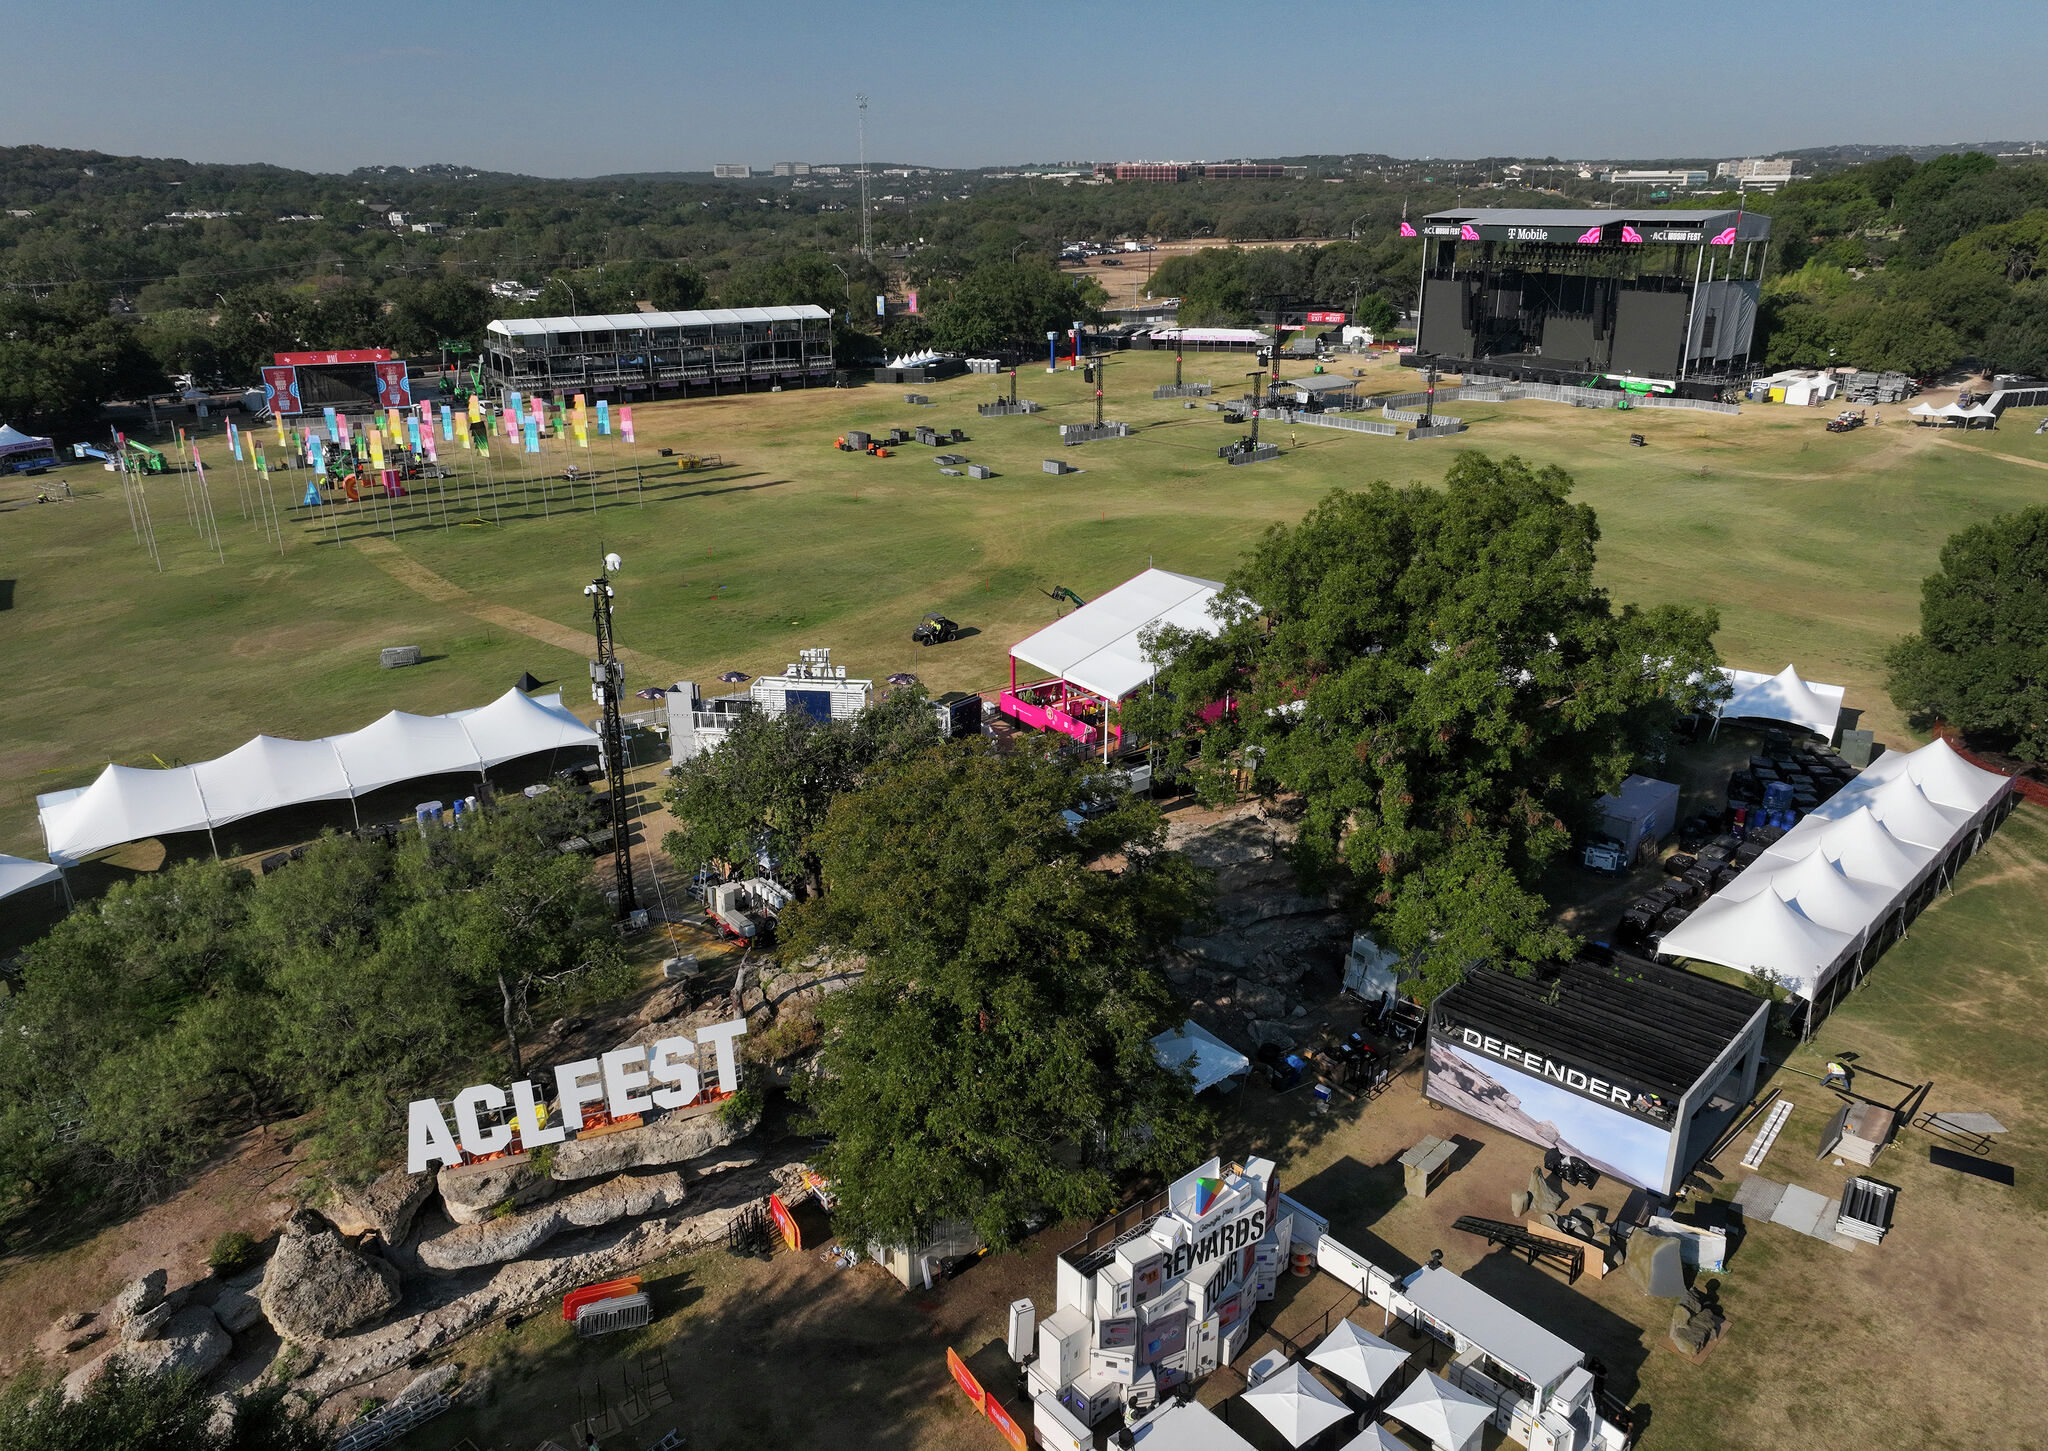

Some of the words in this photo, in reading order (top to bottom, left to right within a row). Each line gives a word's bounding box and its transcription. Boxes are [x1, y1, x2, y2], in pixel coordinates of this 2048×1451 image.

[1517, 228, 1548, 240] Mobile
[1652, 231, 1667, 240] ACL
[1687, 232, 1702, 241] FEST
[408, 1018, 747, 1175] ACLFEST
[1463, 1027, 1631, 1108] DEFENDER
[1162, 1210, 1265, 1280] REWARDS
[1204, 1250, 1238, 1313] TOUR
